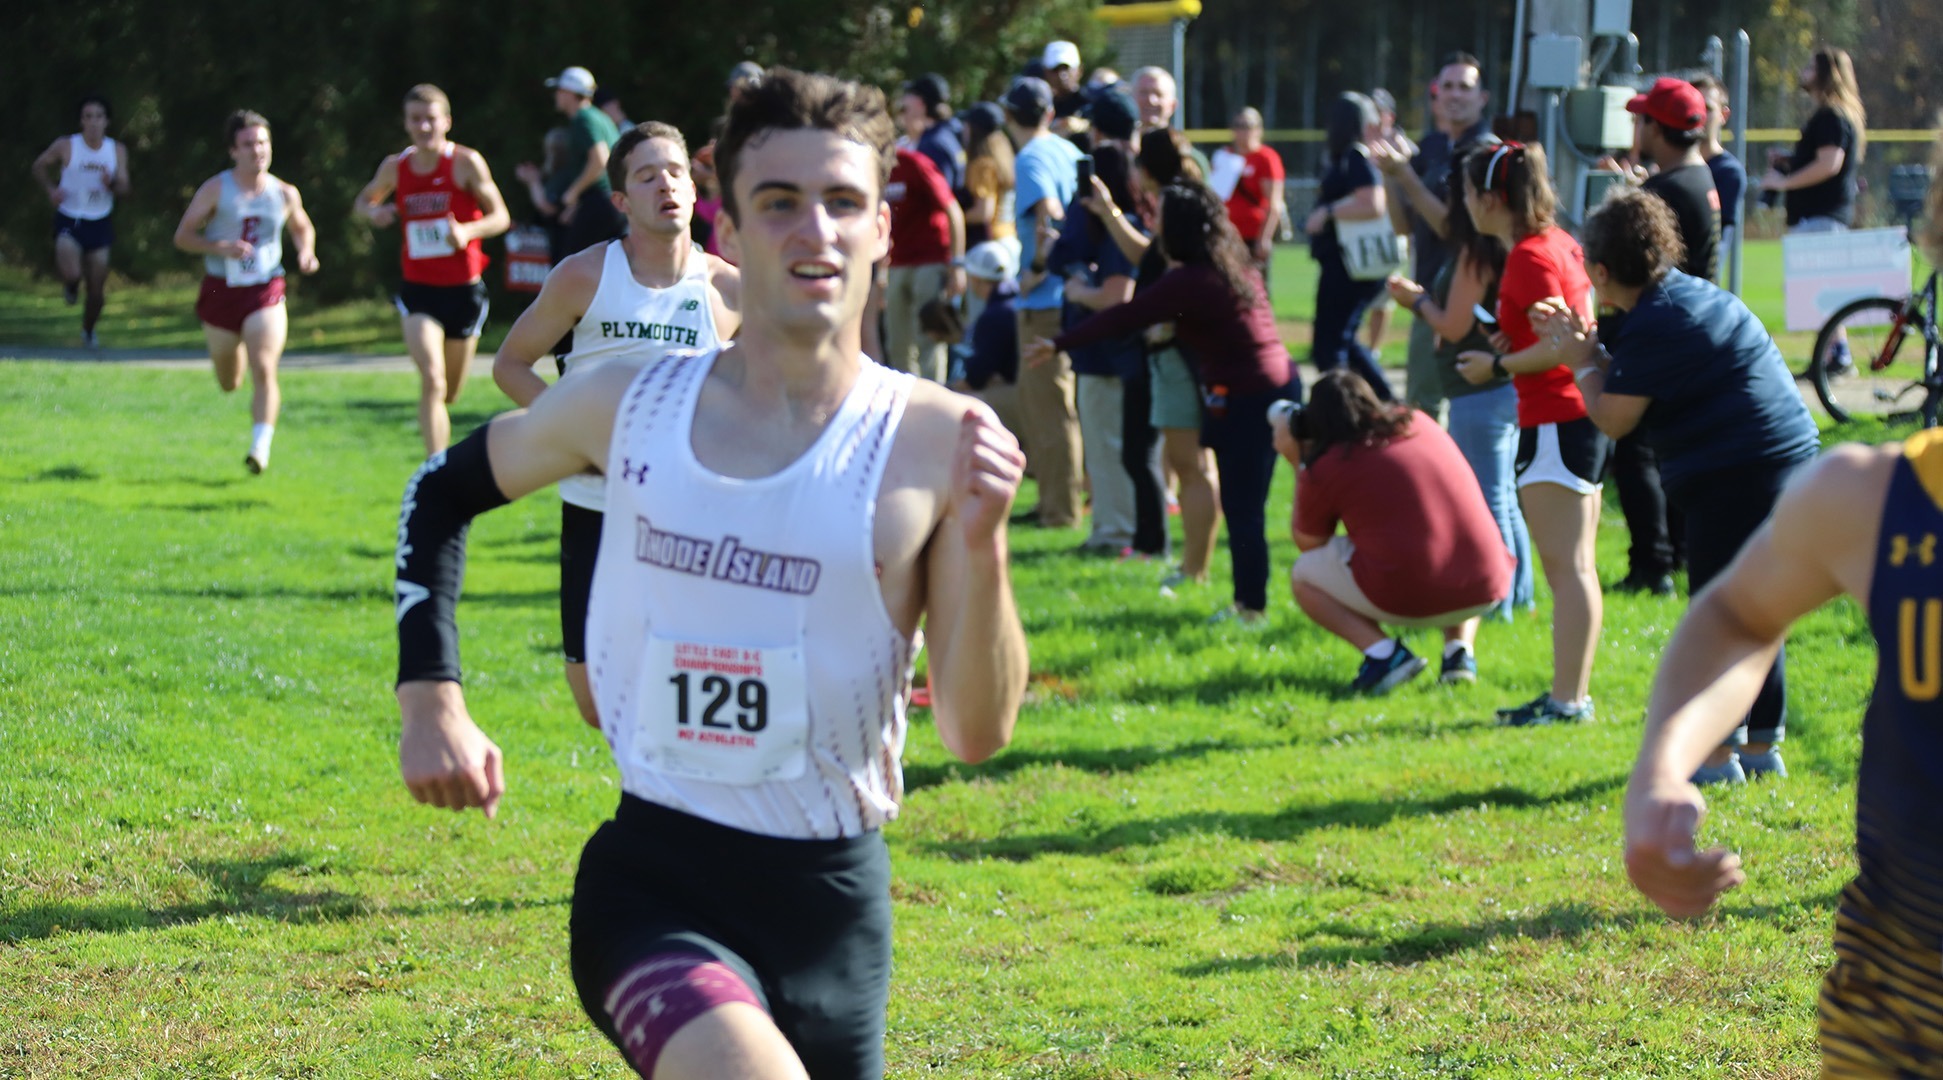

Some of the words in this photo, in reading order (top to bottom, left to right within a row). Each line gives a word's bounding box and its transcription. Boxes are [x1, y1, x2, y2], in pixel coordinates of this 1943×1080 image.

[601, 321, 699, 346] PLYMOUTH
[636, 515, 712, 577] RHODE
[711, 534, 822, 596] ISLAND
[668, 672, 768, 733] 129
